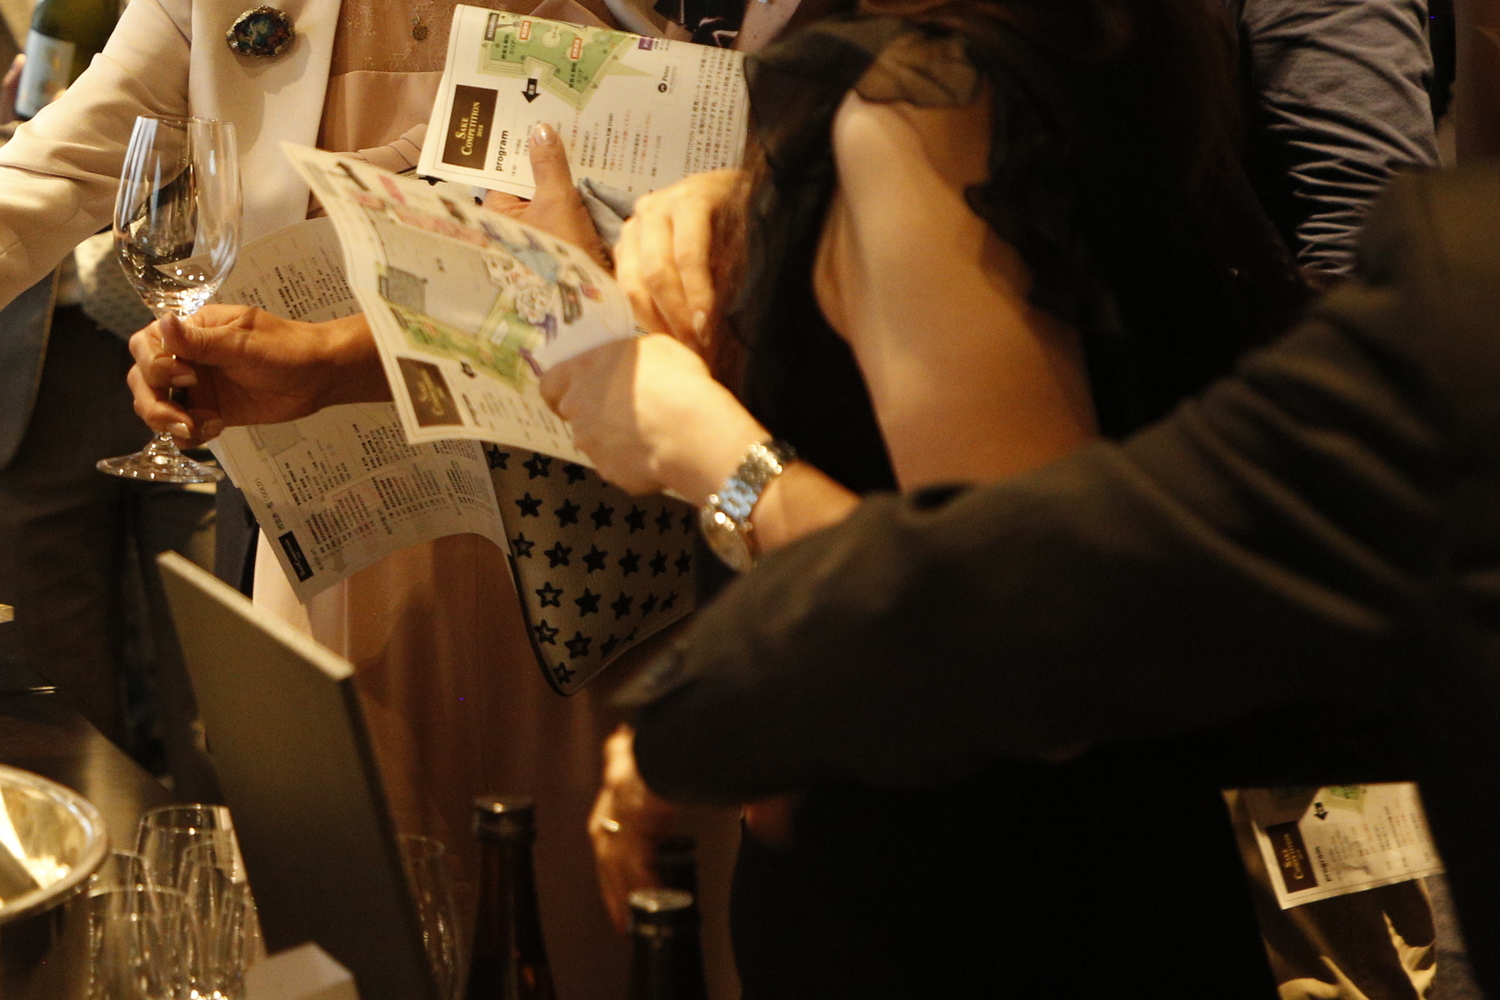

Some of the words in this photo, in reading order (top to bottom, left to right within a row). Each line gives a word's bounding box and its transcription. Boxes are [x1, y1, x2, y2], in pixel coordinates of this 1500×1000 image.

[455, 117, 469, 139] SAKE
[461, 101, 480, 156] COMPETITION
[495, 130, 509, 172] program
